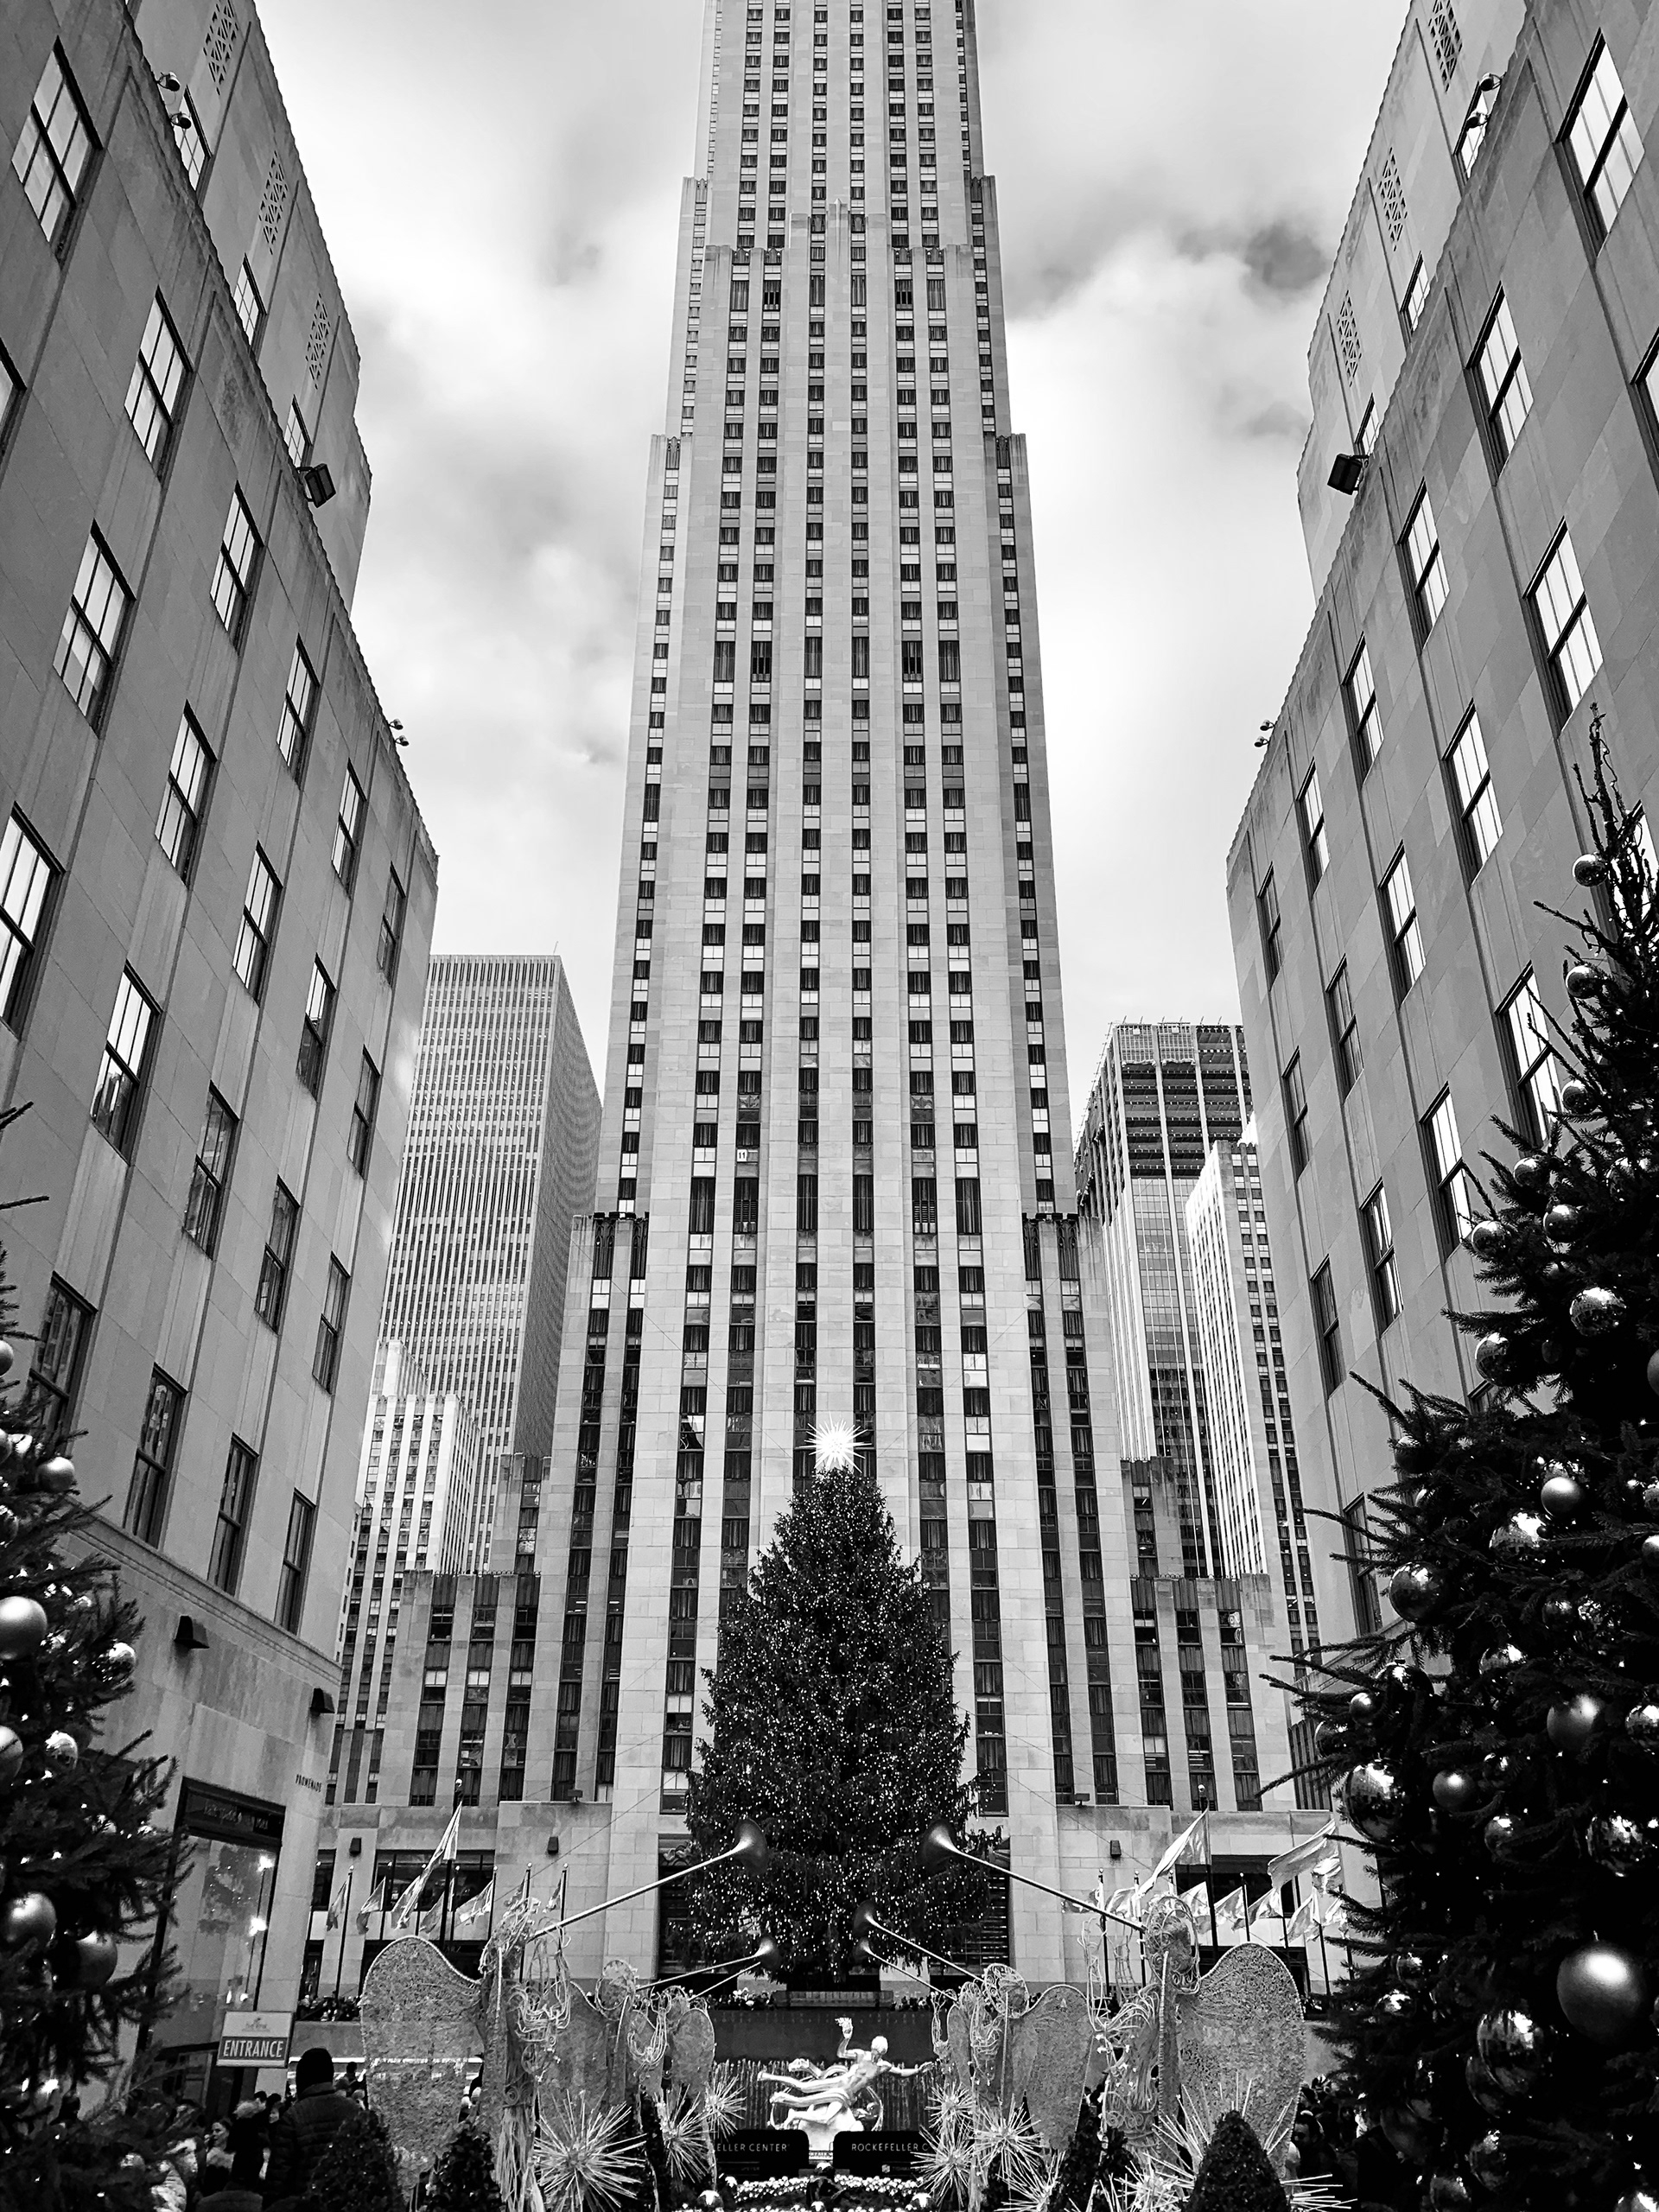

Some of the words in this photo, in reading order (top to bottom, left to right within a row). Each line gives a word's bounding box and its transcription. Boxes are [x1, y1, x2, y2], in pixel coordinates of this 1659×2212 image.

[296, 1774, 321, 1793] PROMENADE
[223, 2039, 283, 2058] ENTRANCE
[716, 2143, 746, 2152] ELLER
[748, 2143, 787, 2152] CENTER
[851, 2143, 918, 2152] ROCKEFELLER
